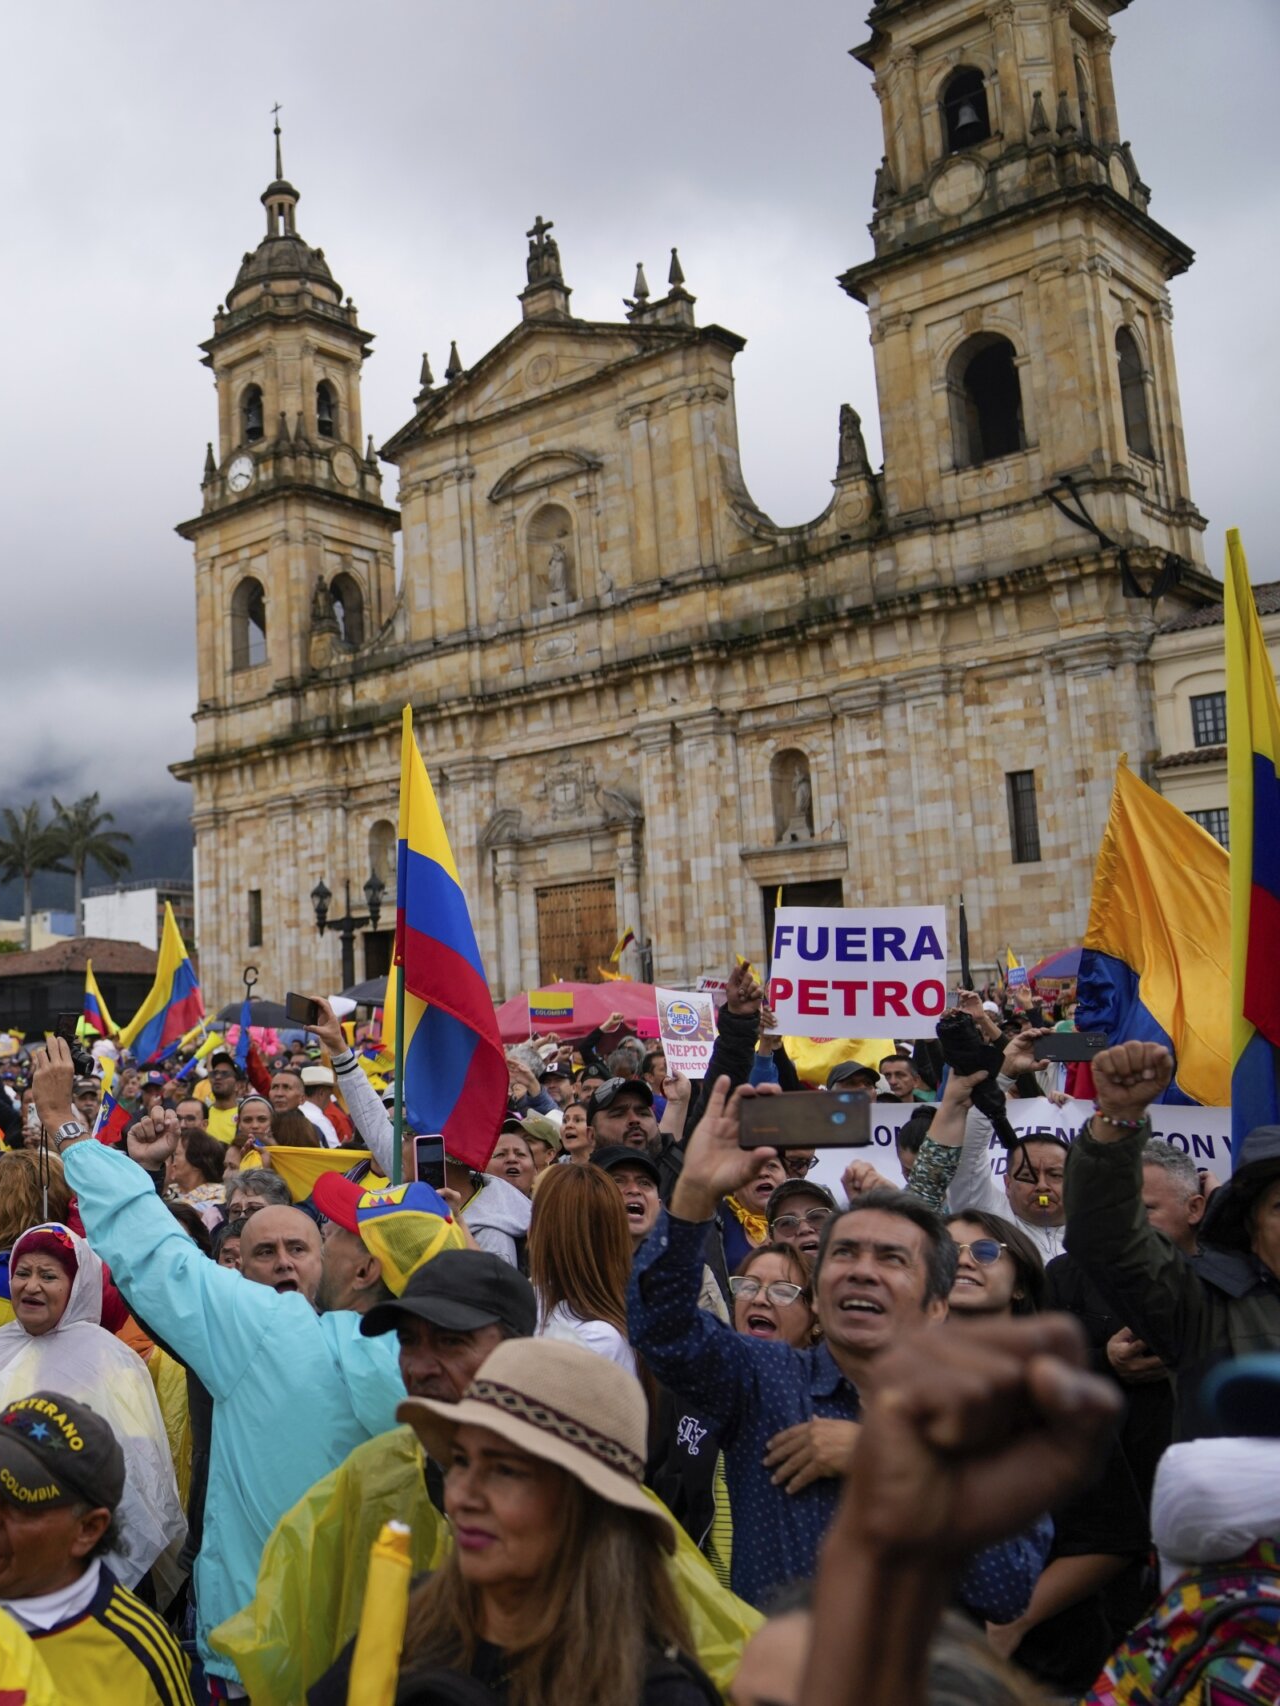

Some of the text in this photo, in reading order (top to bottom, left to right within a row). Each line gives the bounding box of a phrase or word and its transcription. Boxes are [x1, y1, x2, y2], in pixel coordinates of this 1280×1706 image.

[773, 925, 945, 962] FUERA
[769, 977, 946, 1017] PETRO
[672, 1018, 698, 1026] PETRO
[0, 1468, 60, 1502] COLOMBIA
